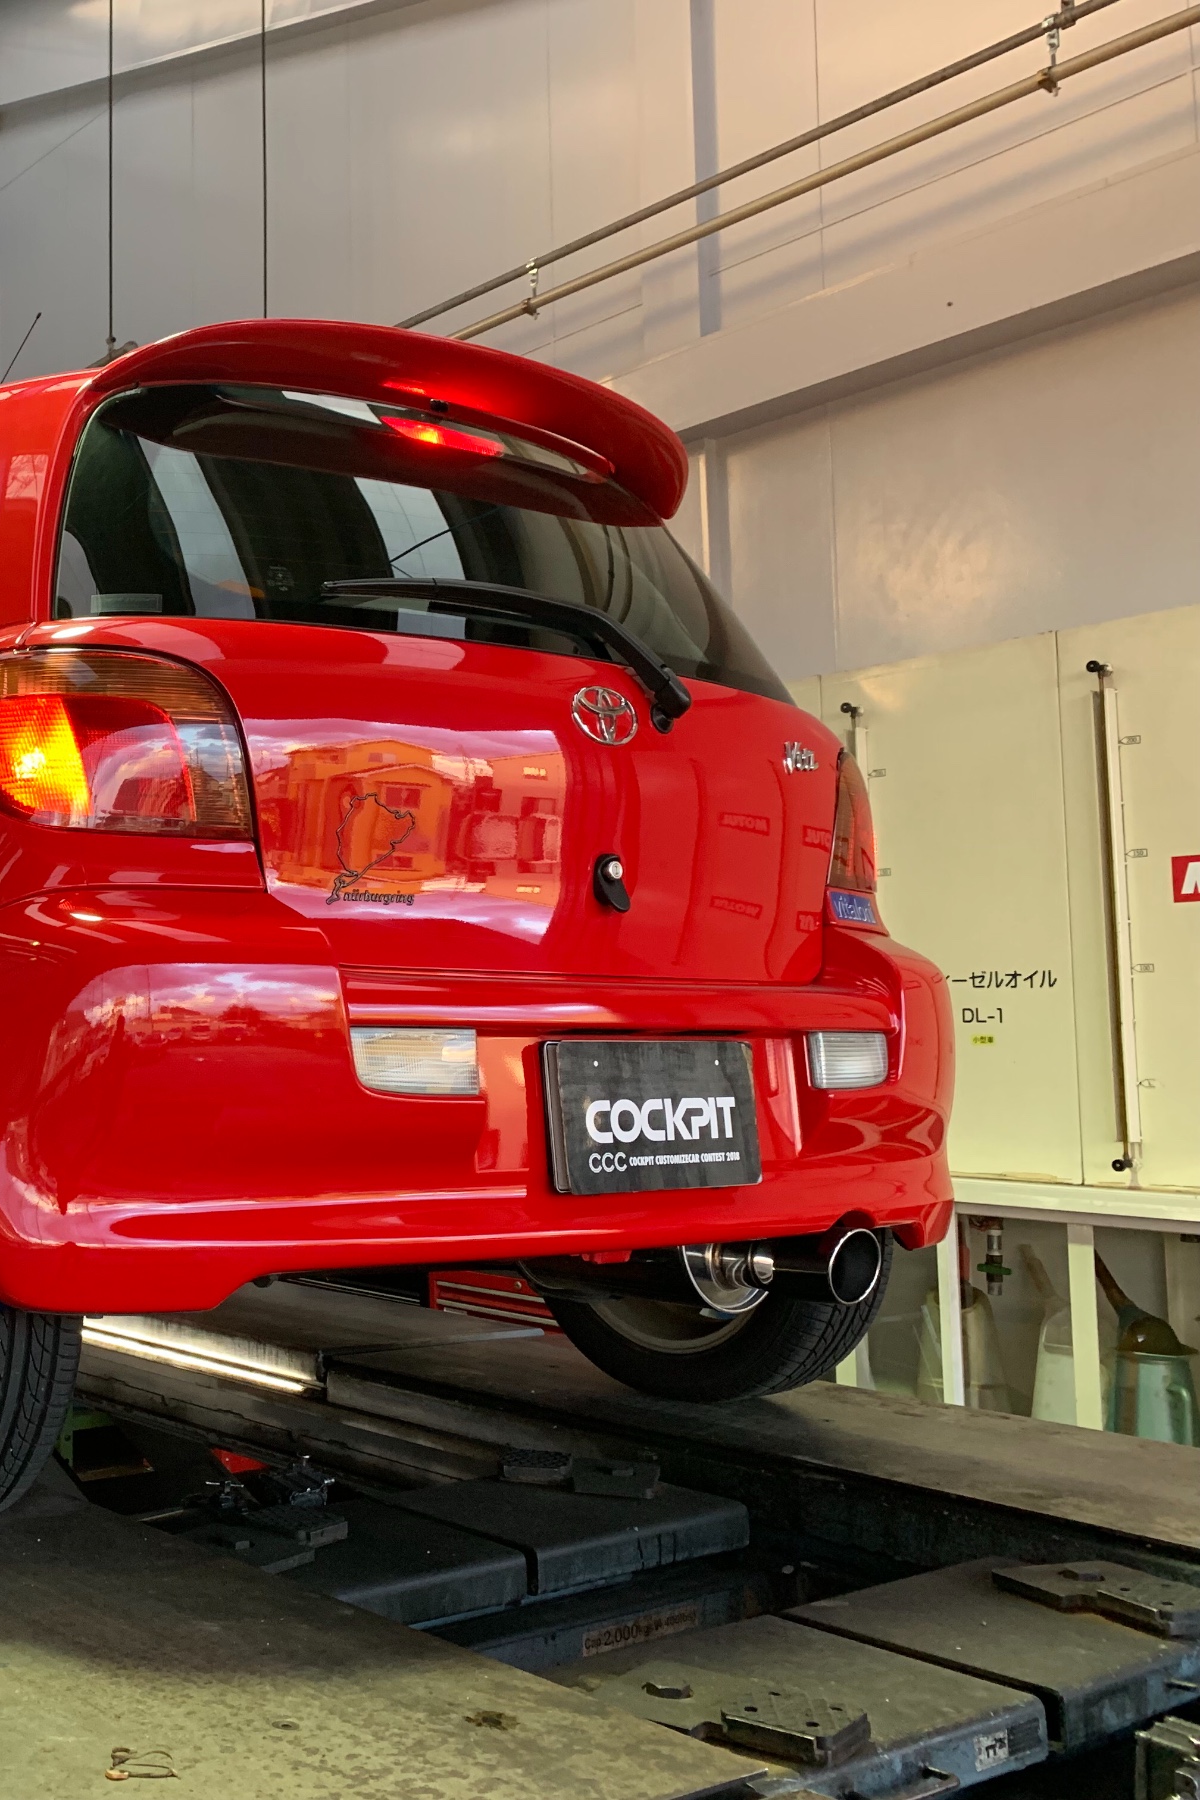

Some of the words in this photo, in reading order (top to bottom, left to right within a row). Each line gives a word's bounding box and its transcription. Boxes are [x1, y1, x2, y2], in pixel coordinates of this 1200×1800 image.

[961, 1007, 1004, 1024] DL-1
[585, 1096, 736, 1144] COCKPIT
[588, 1151, 628, 1173] CCC
[629, 1156, 654, 1167] COCKPIT
[655, 1153, 700, 1166] CUSTOMIZECAR
[700, 1151, 725, 1163] CONTEST
[725, 1151, 740, 1161] 2018
